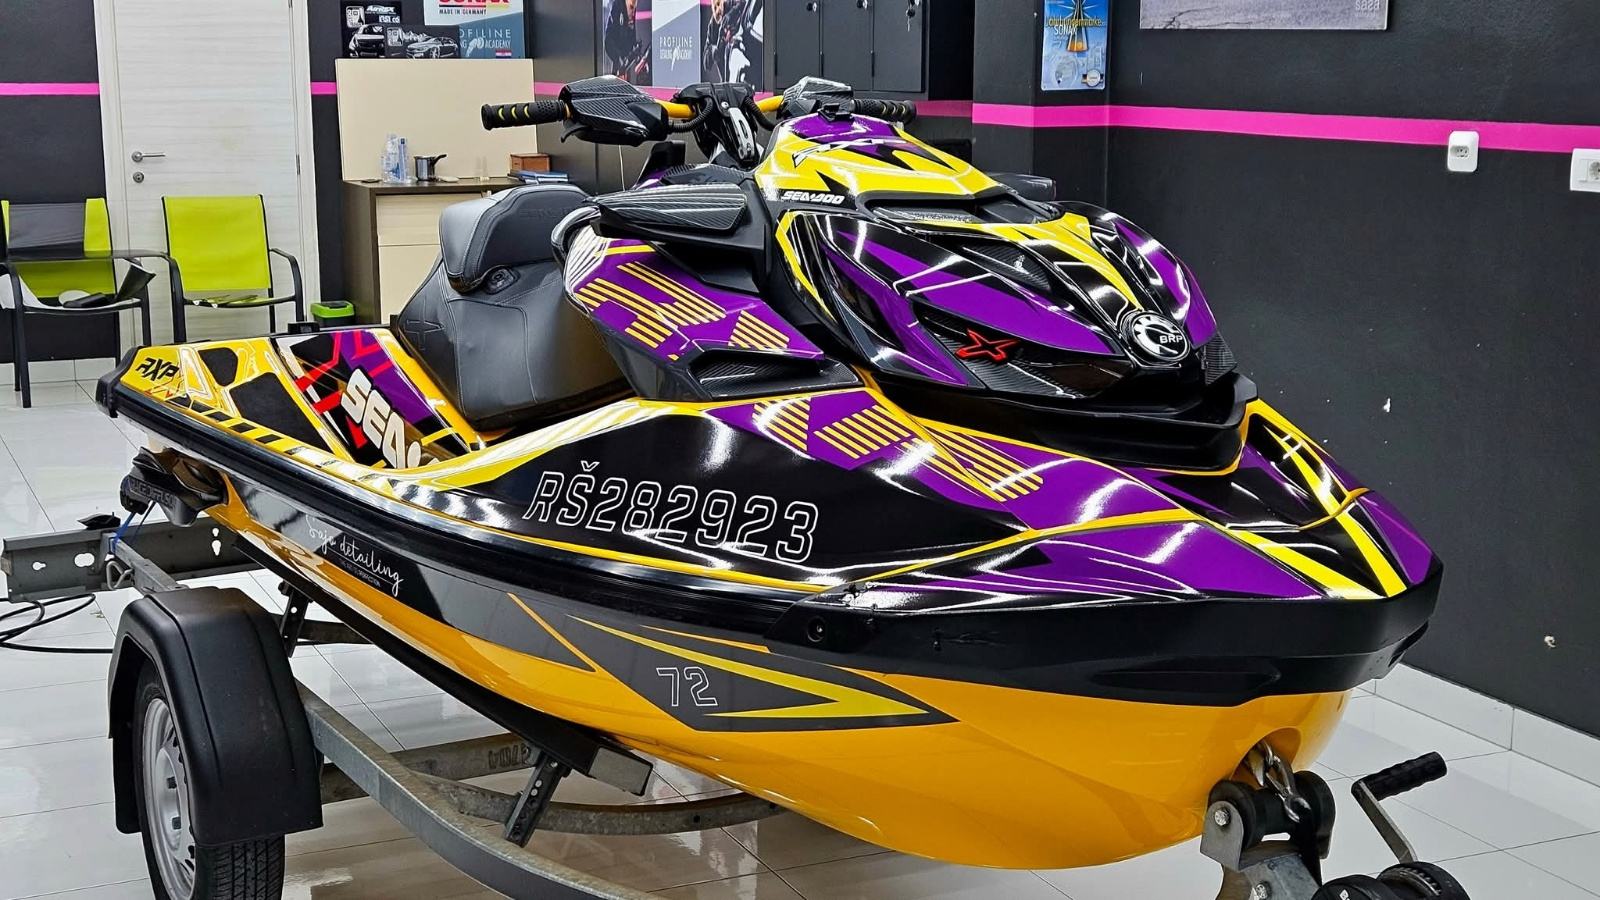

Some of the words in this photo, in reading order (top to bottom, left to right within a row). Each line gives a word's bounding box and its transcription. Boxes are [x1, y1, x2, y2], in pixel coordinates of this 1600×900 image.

[485, 40, 512, 49] ACADEMY
[1160, 335, 1182, 344] BRP
[522, 460, 819, 563] RŠ282923
[340, 536, 404, 597] detailing
[656, 666, 718, 706] 72
